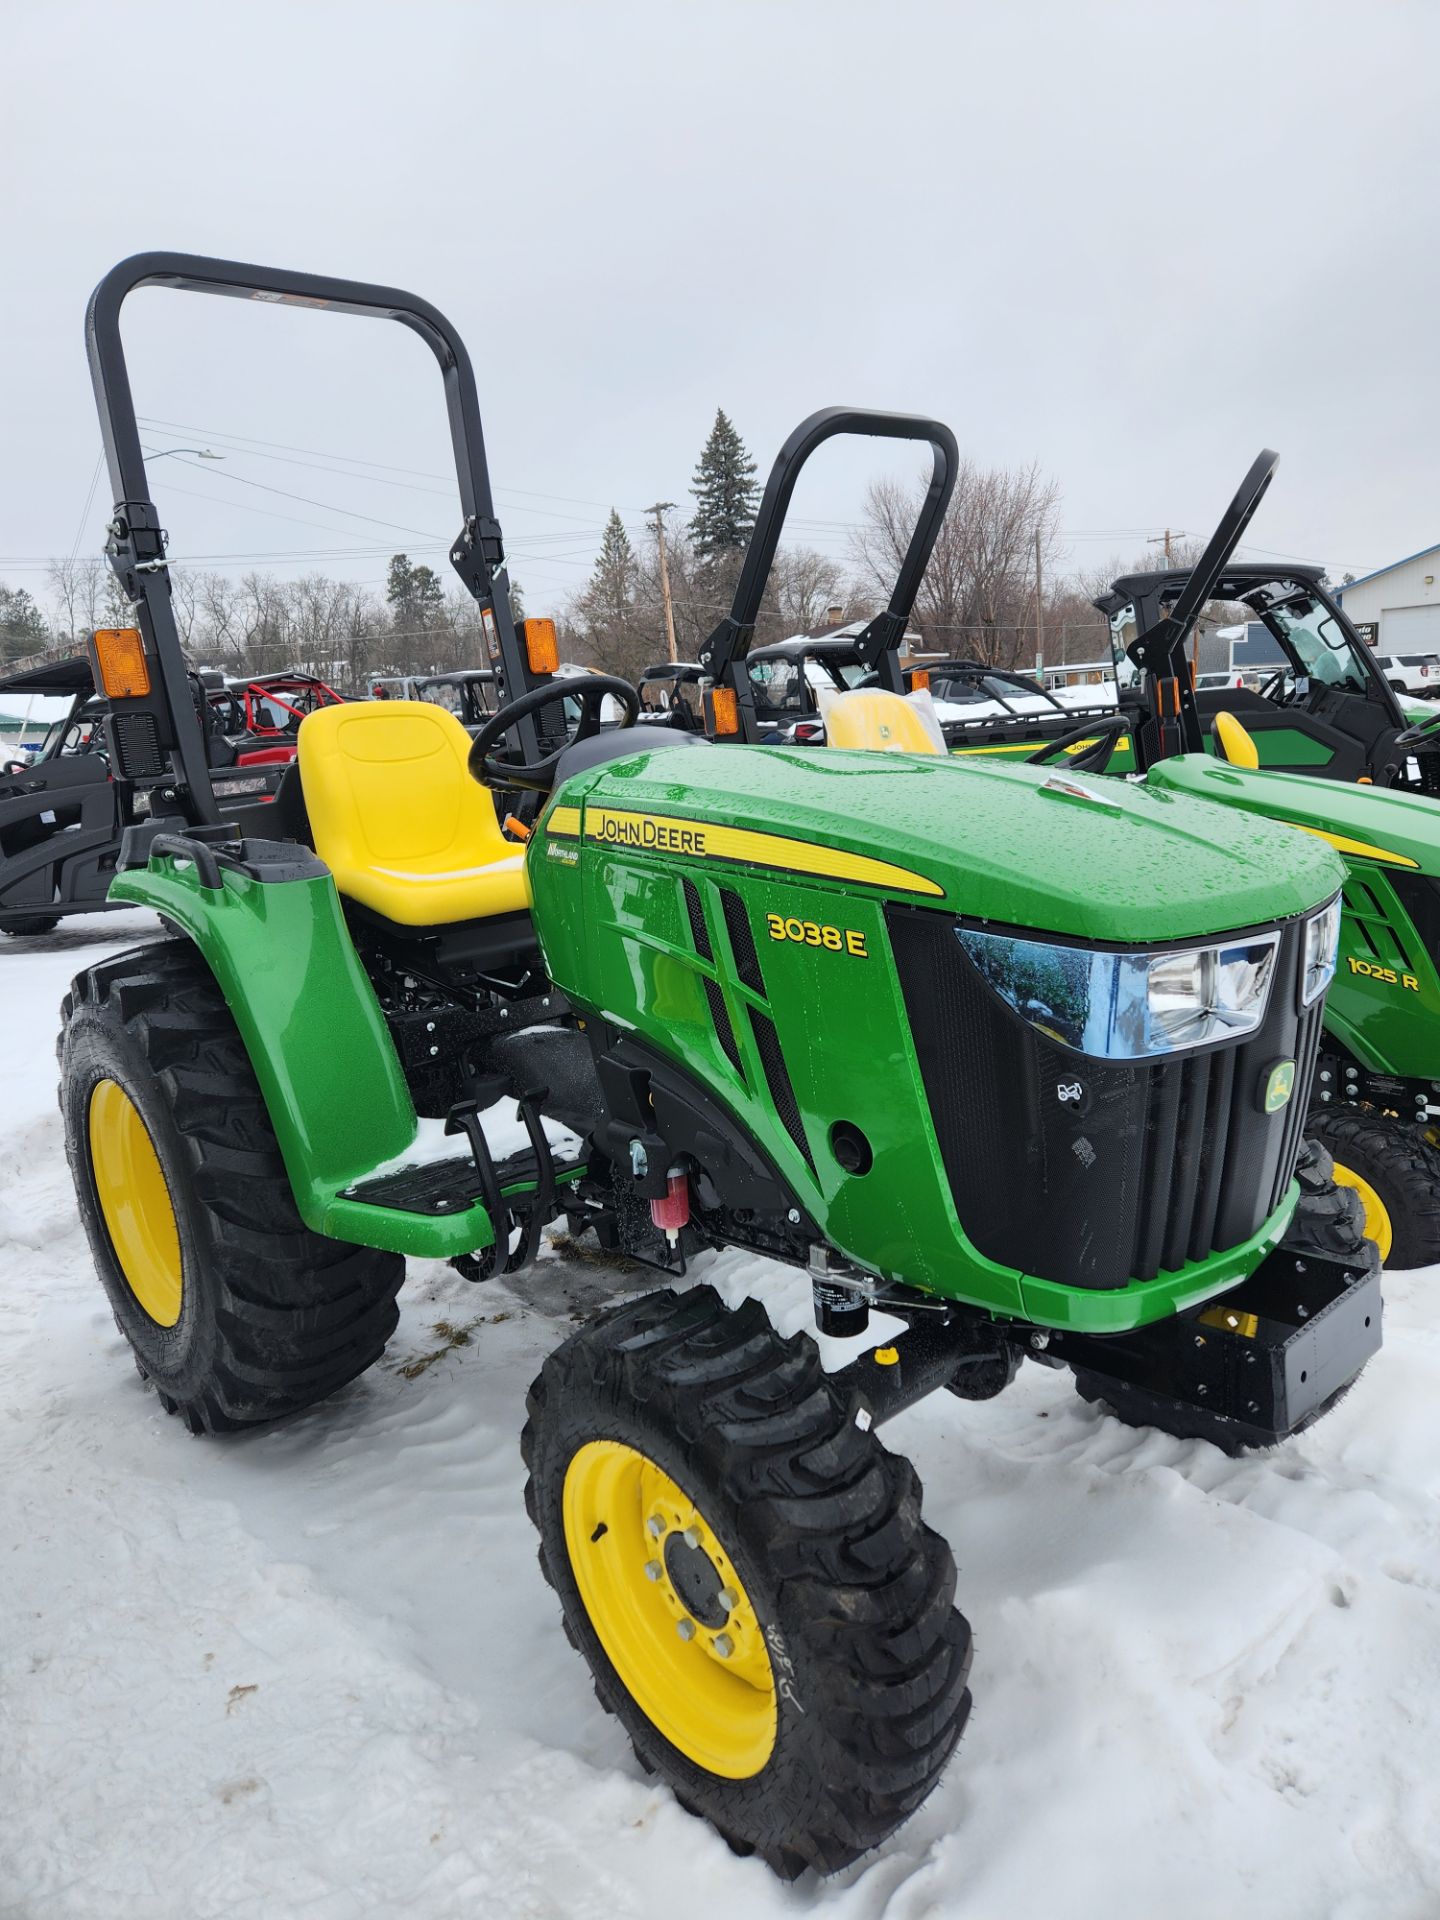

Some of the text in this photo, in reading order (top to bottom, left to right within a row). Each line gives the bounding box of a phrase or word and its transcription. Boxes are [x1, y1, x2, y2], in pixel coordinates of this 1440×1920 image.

[1072, 743, 1091, 752] JOH
[598, 814, 706, 853] JOHN DEERE
[766, 912, 869, 959] 3038 E
[1347, 956, 1419, 992] 1025 R
